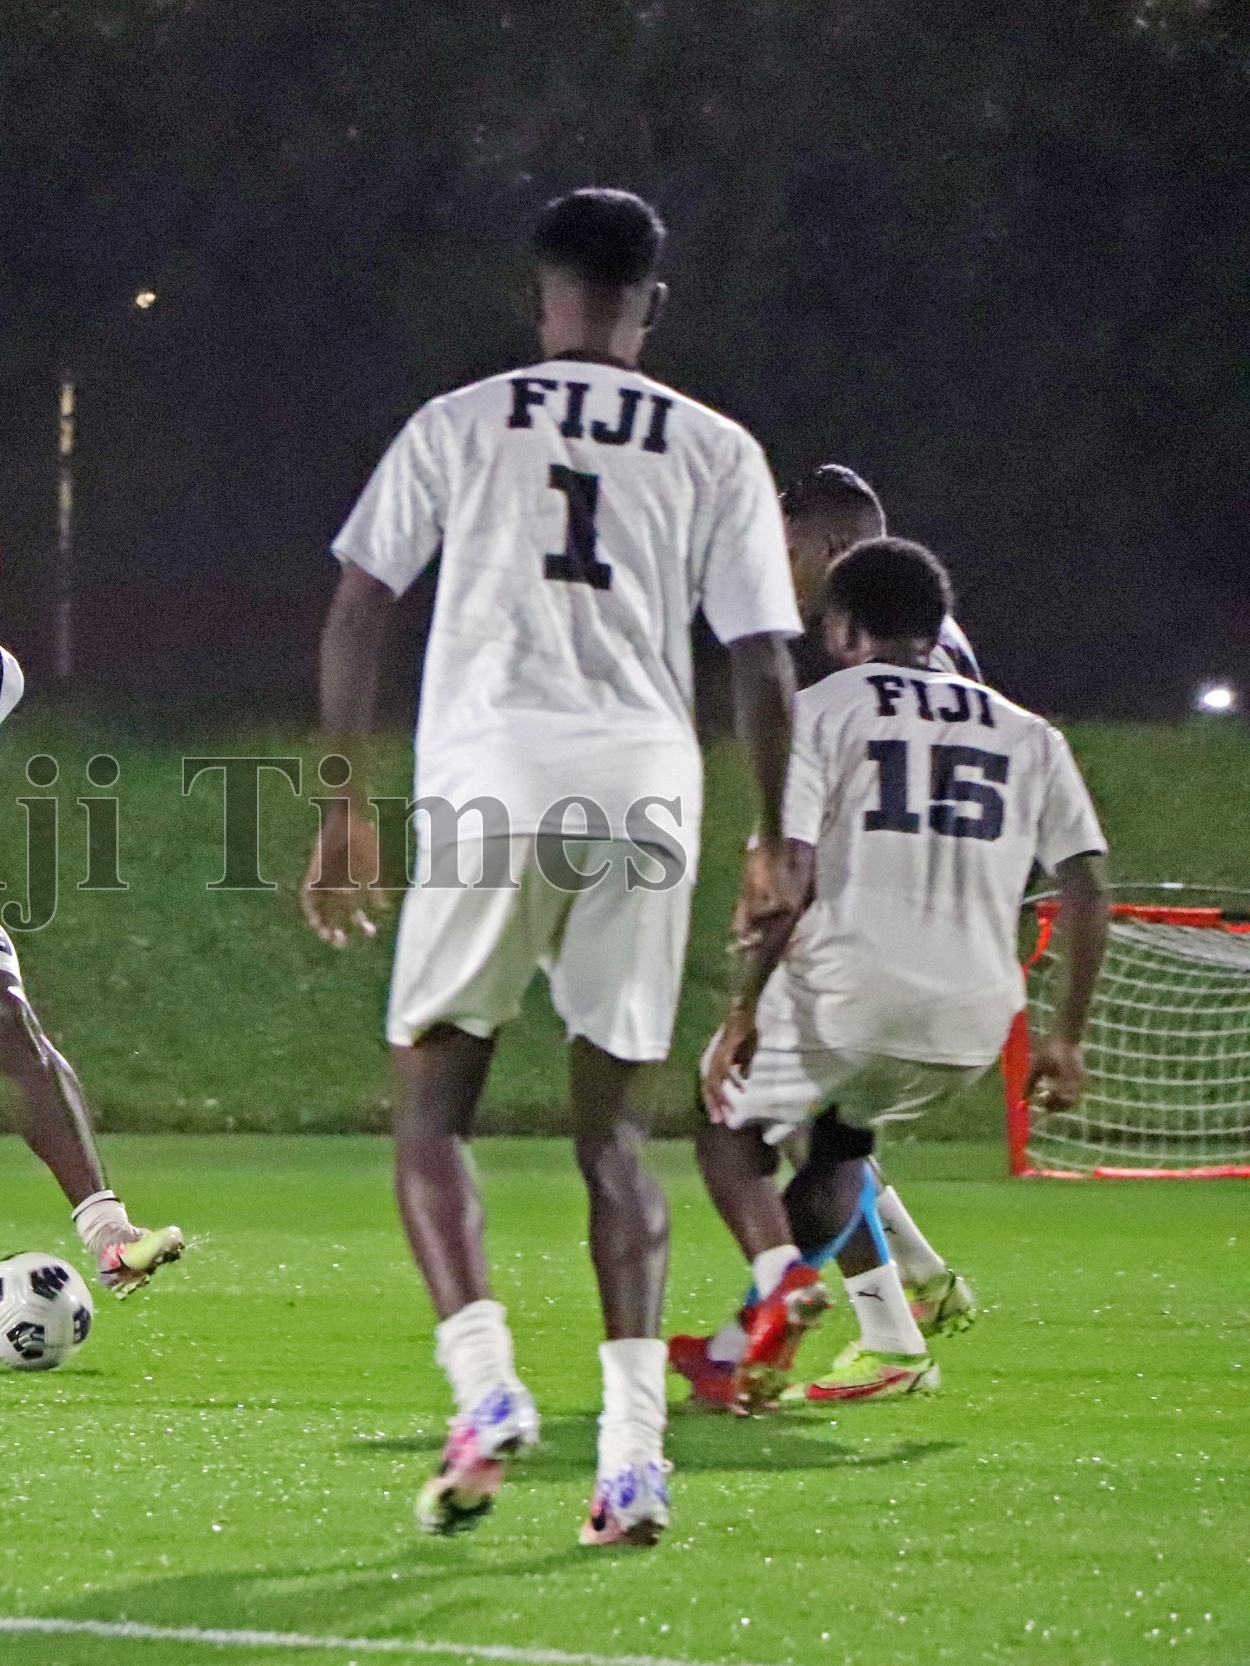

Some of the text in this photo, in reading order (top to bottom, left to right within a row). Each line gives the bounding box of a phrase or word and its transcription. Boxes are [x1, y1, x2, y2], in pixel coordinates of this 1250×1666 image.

[506, 376, 675, 454] FIJI
[543, 464, 612, 590] 1
[865, 674, 995, 728] FIJI
[864, 739, 1010, 842] 15
